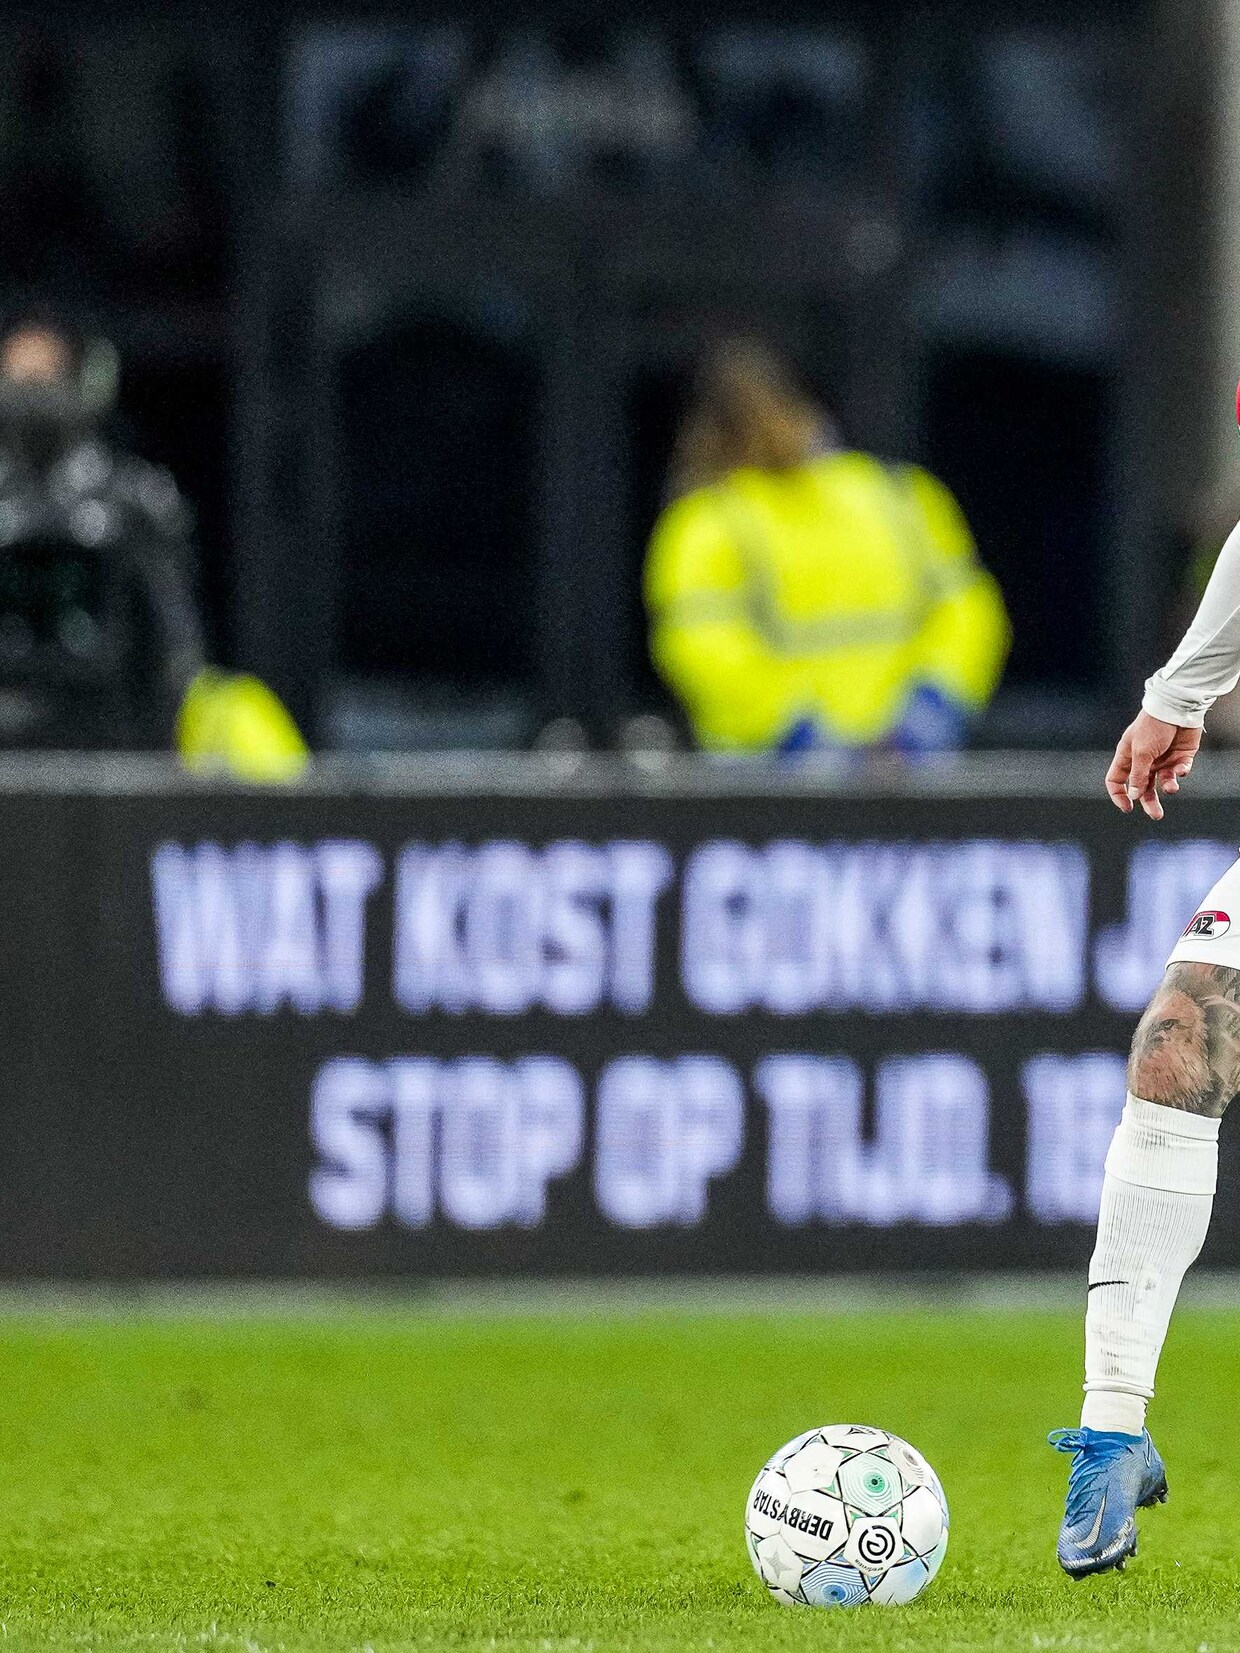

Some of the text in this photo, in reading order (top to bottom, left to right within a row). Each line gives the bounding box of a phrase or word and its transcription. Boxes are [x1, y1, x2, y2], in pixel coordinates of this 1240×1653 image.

[152, 841, 380, 1012] WAT
[394, 841, 671, 1013] KOST
[682, 840, 1088, 1013] GOKKEN
[310, 1056, 583, 1229] STOP
[595, 1055, 743, 1227] OP
[753, 1489, 834, 1541] DERBYSTAR
